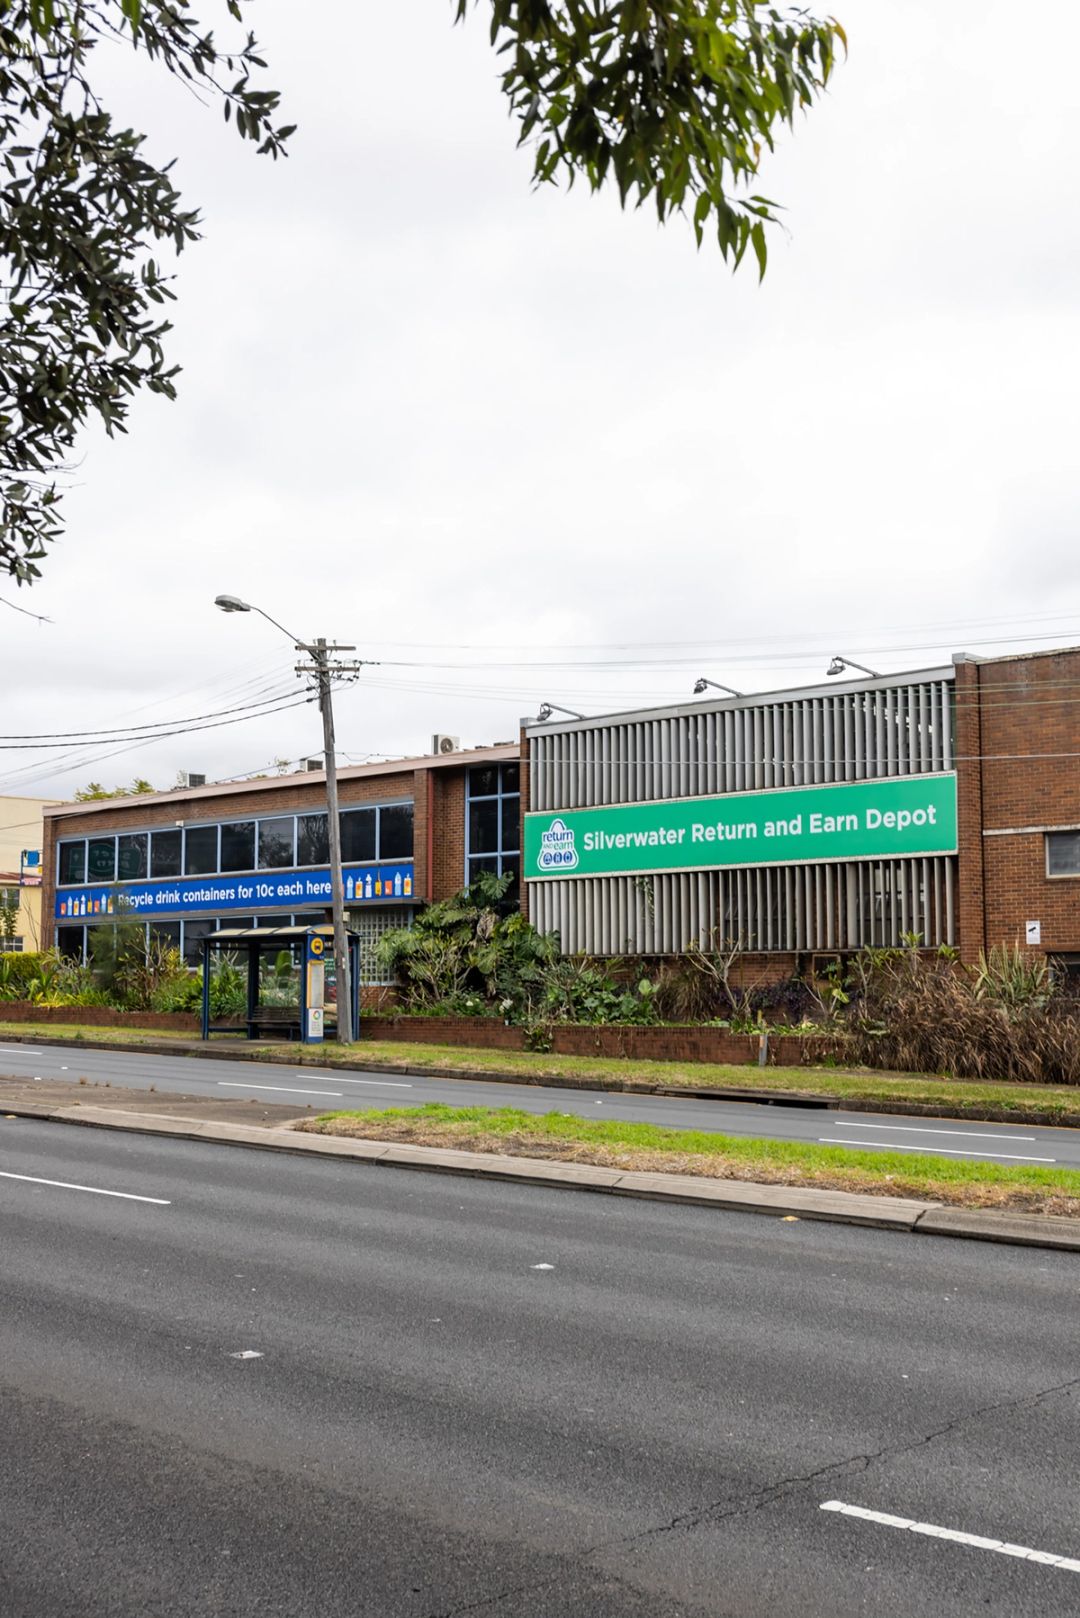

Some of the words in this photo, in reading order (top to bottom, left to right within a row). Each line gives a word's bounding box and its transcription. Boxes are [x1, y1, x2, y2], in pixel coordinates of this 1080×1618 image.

[543, 831, 573, 842] return
[583, 827, 686, 851] Silverwater
[691, 822, 758, 843] Return
[763, 814, 802, 837] and
[809, 813, 858, 834] Earn
[866, 804, 937, 831] Depot
[553, 841, 573, 850] earn
[118, 891, 153, 908] Recycle
[155, 889, 180, 904] drink
[182, 887, 235, 903] containers
[238, 884, 254, 899] for
[255, 883, 274, 898] 10c
[277, 880, 303, 896] each
[306, 880, 332, 895] here
